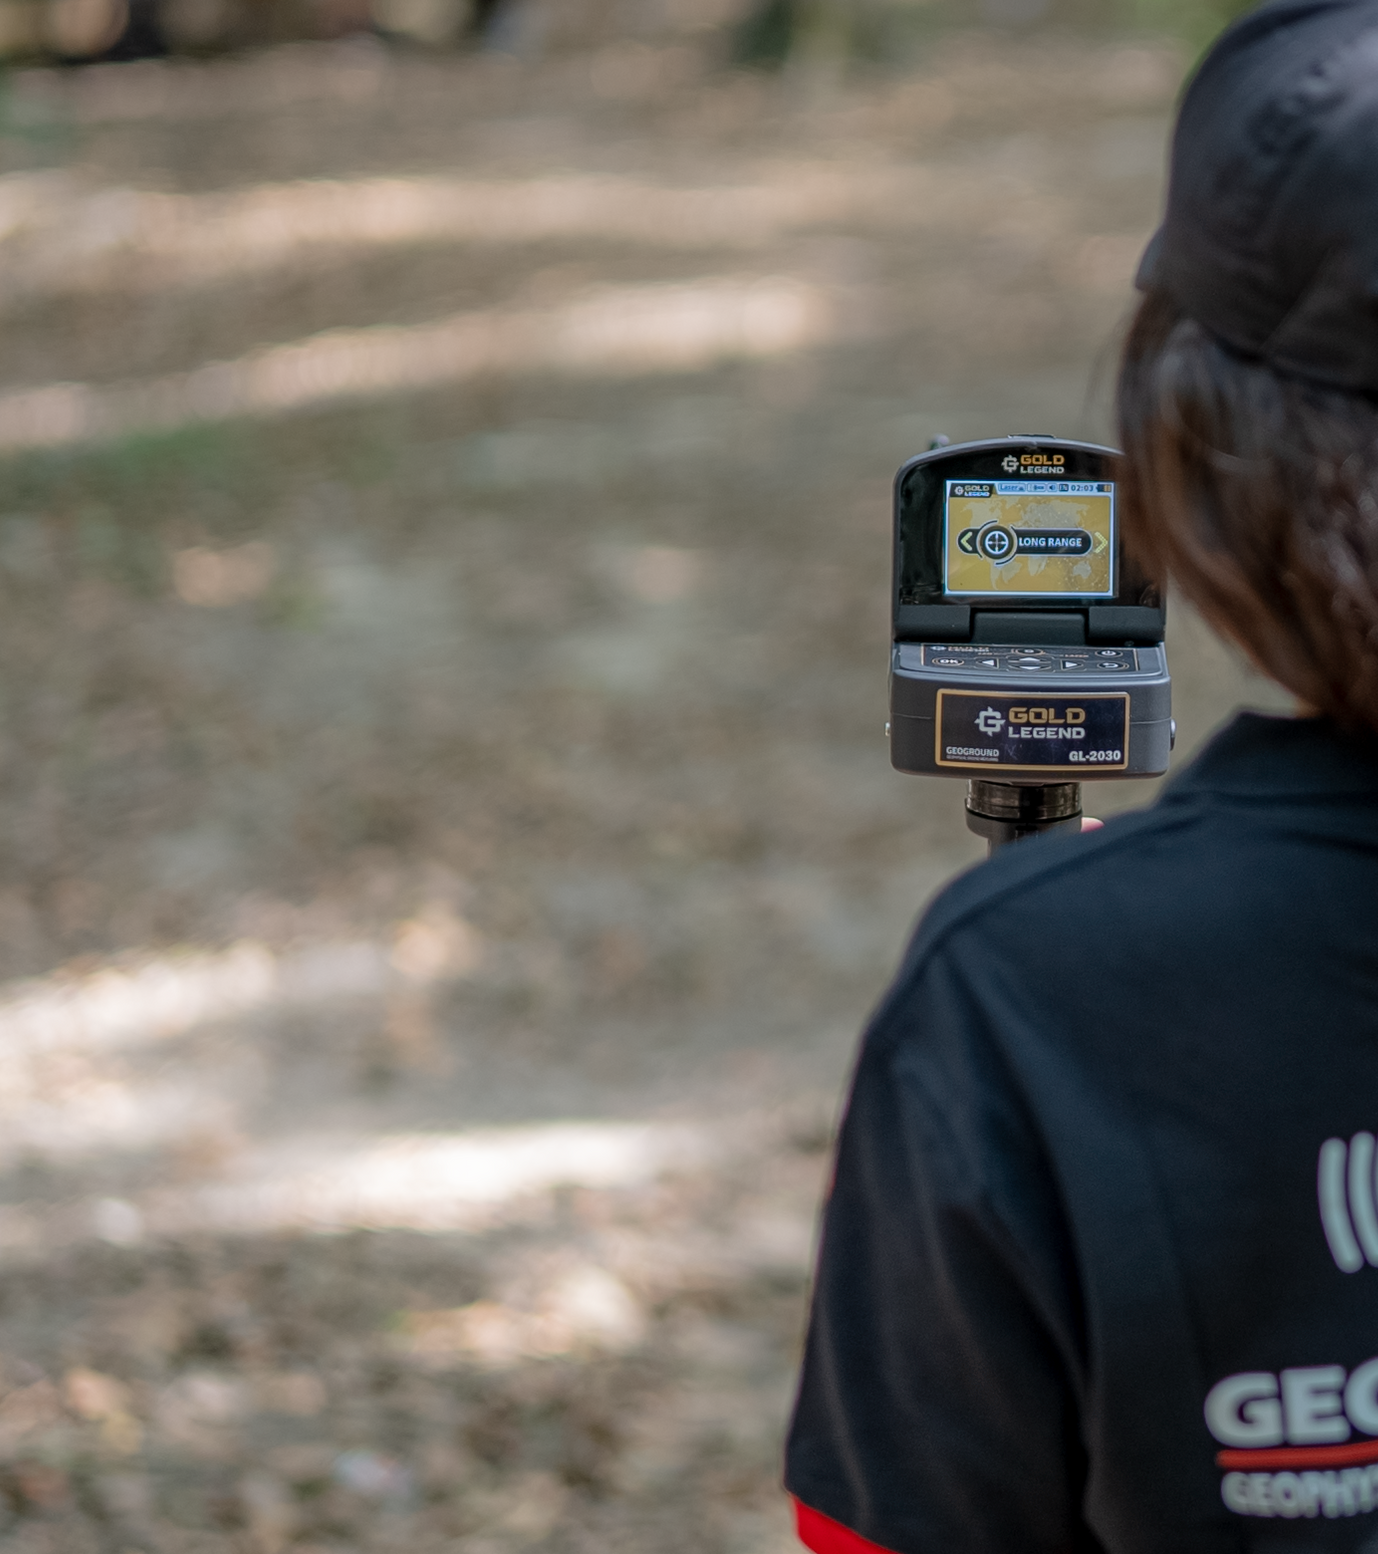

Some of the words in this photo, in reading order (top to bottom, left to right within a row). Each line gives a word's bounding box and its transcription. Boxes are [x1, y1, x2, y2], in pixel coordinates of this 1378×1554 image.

[1020, 454, 1065, 465] GOLD
[1020, 466, 1065, 474] LEGEND
[1018, 537, 1045, 547] LONG
[1048, 537, 1082, 548] RANGE
[1008, 707, 1086, 724] GOLD
[1008, 727, 1086, 739] LEGEND
[946, 746, 1000, 757] GEOGROUND
[1068, 750, 1122, 762] GL-2030
